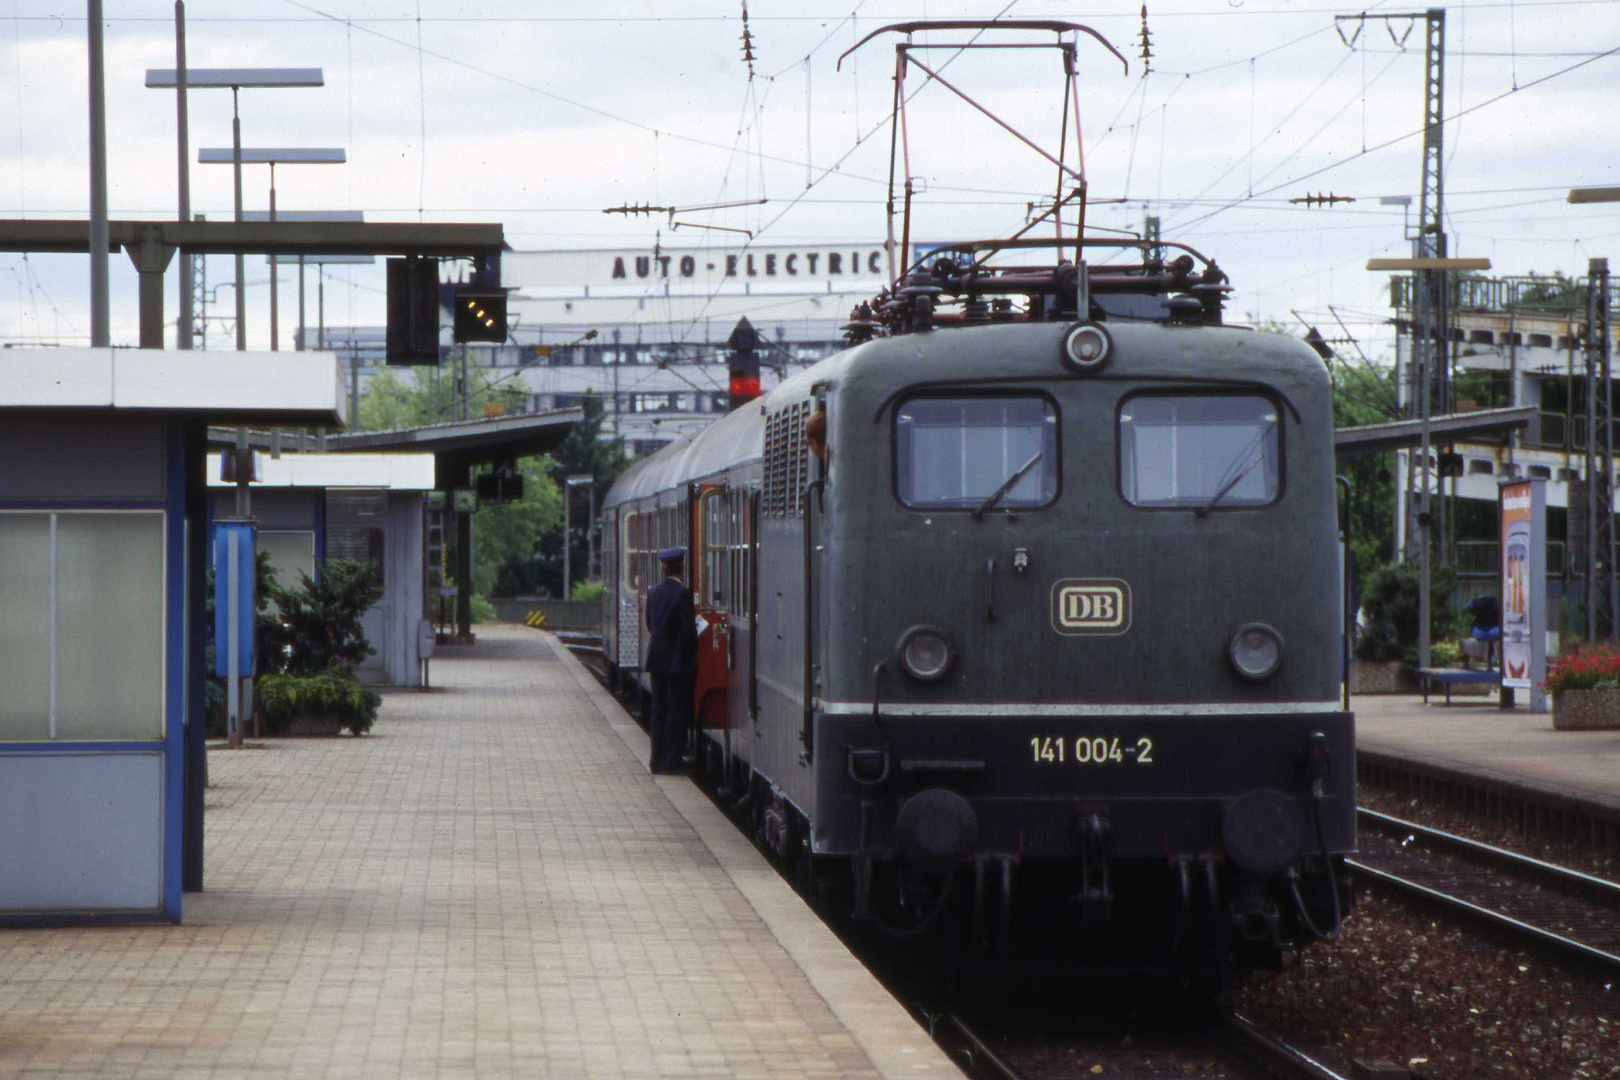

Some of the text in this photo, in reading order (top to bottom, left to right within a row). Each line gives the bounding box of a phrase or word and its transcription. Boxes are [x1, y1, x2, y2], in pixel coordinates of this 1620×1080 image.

[1068, 594, 1115, 619] DB
[1030, 737, 1153, 763] 141 004-2
